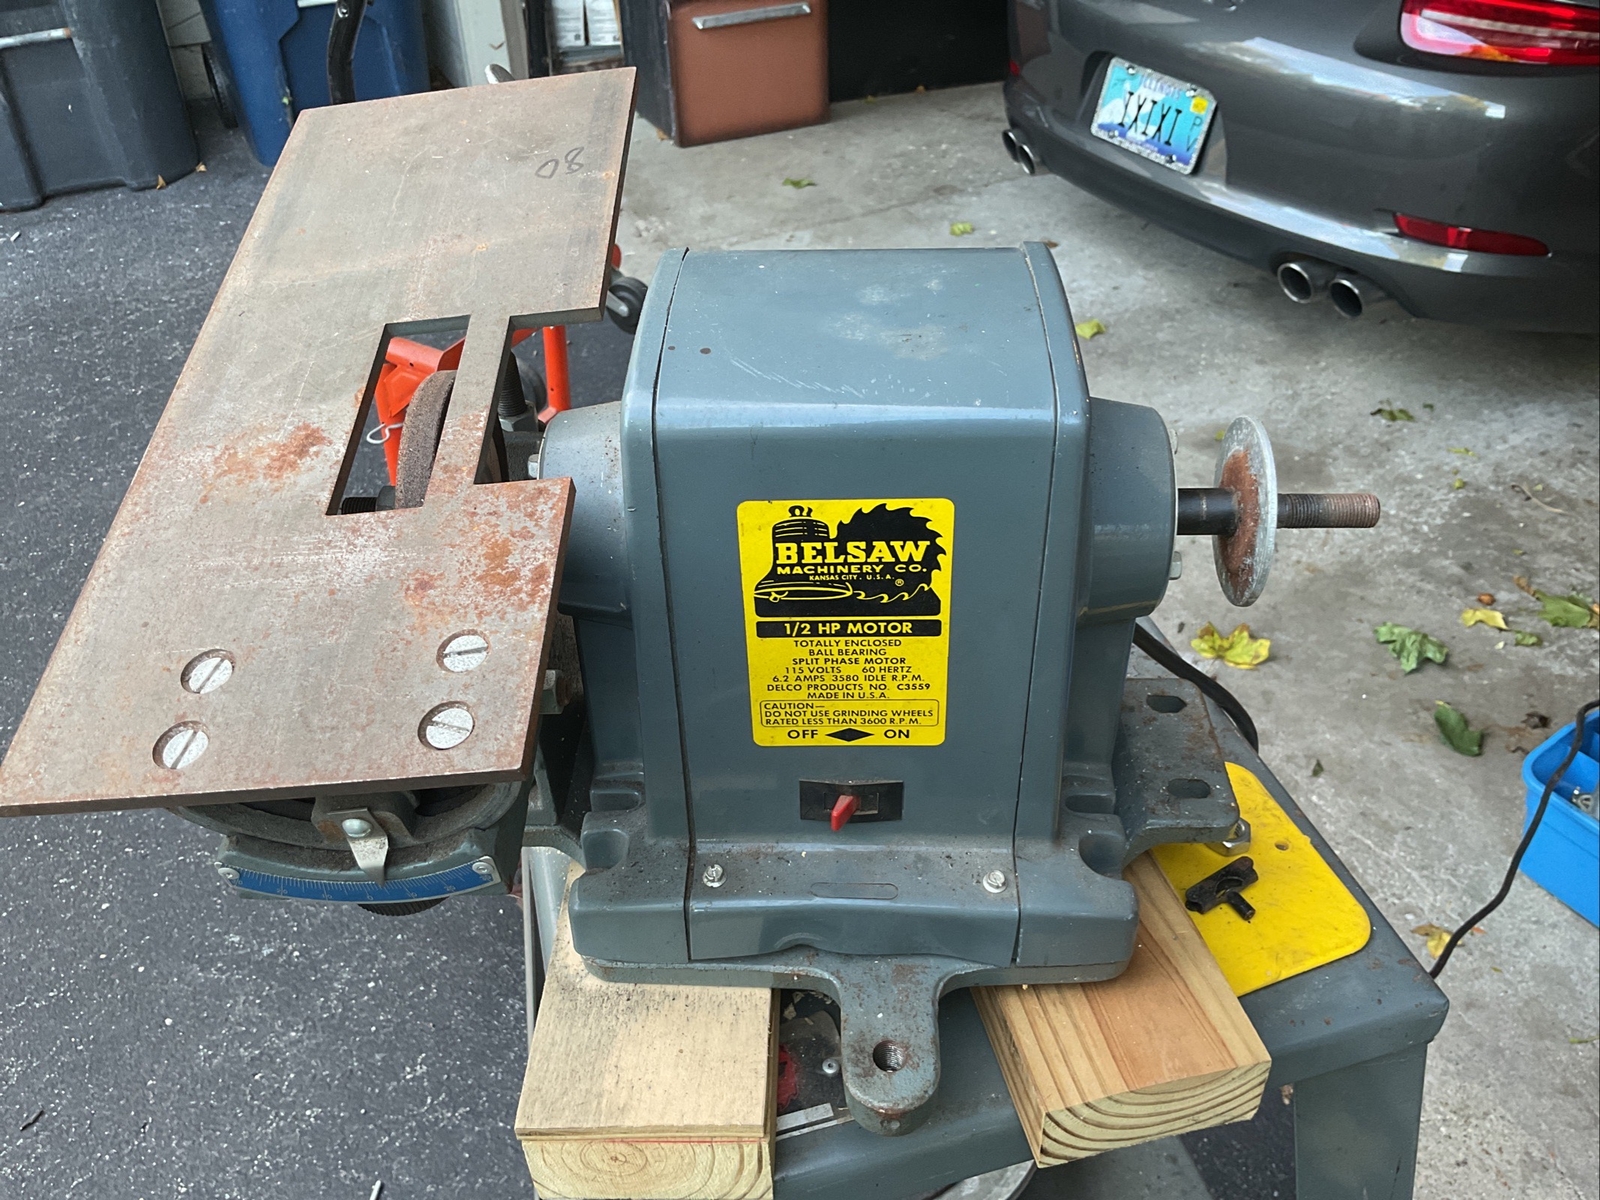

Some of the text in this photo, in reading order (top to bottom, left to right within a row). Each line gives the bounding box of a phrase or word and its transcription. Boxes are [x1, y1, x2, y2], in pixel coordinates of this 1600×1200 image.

[1117, 91, 1182, 146] IXIXI
[775, 541, 930, 564] BELSAW
[777, 564, 927, 574] MACHINERY CO.
[784, 621, 913, 637] 1/2 HP MOTOR
[794, 640, 840, 648] TOTALLY
[785, 666, 912, 674] 115 VOLTS 60 HERTZ
[787, 729, 910, 739] OFF ON
